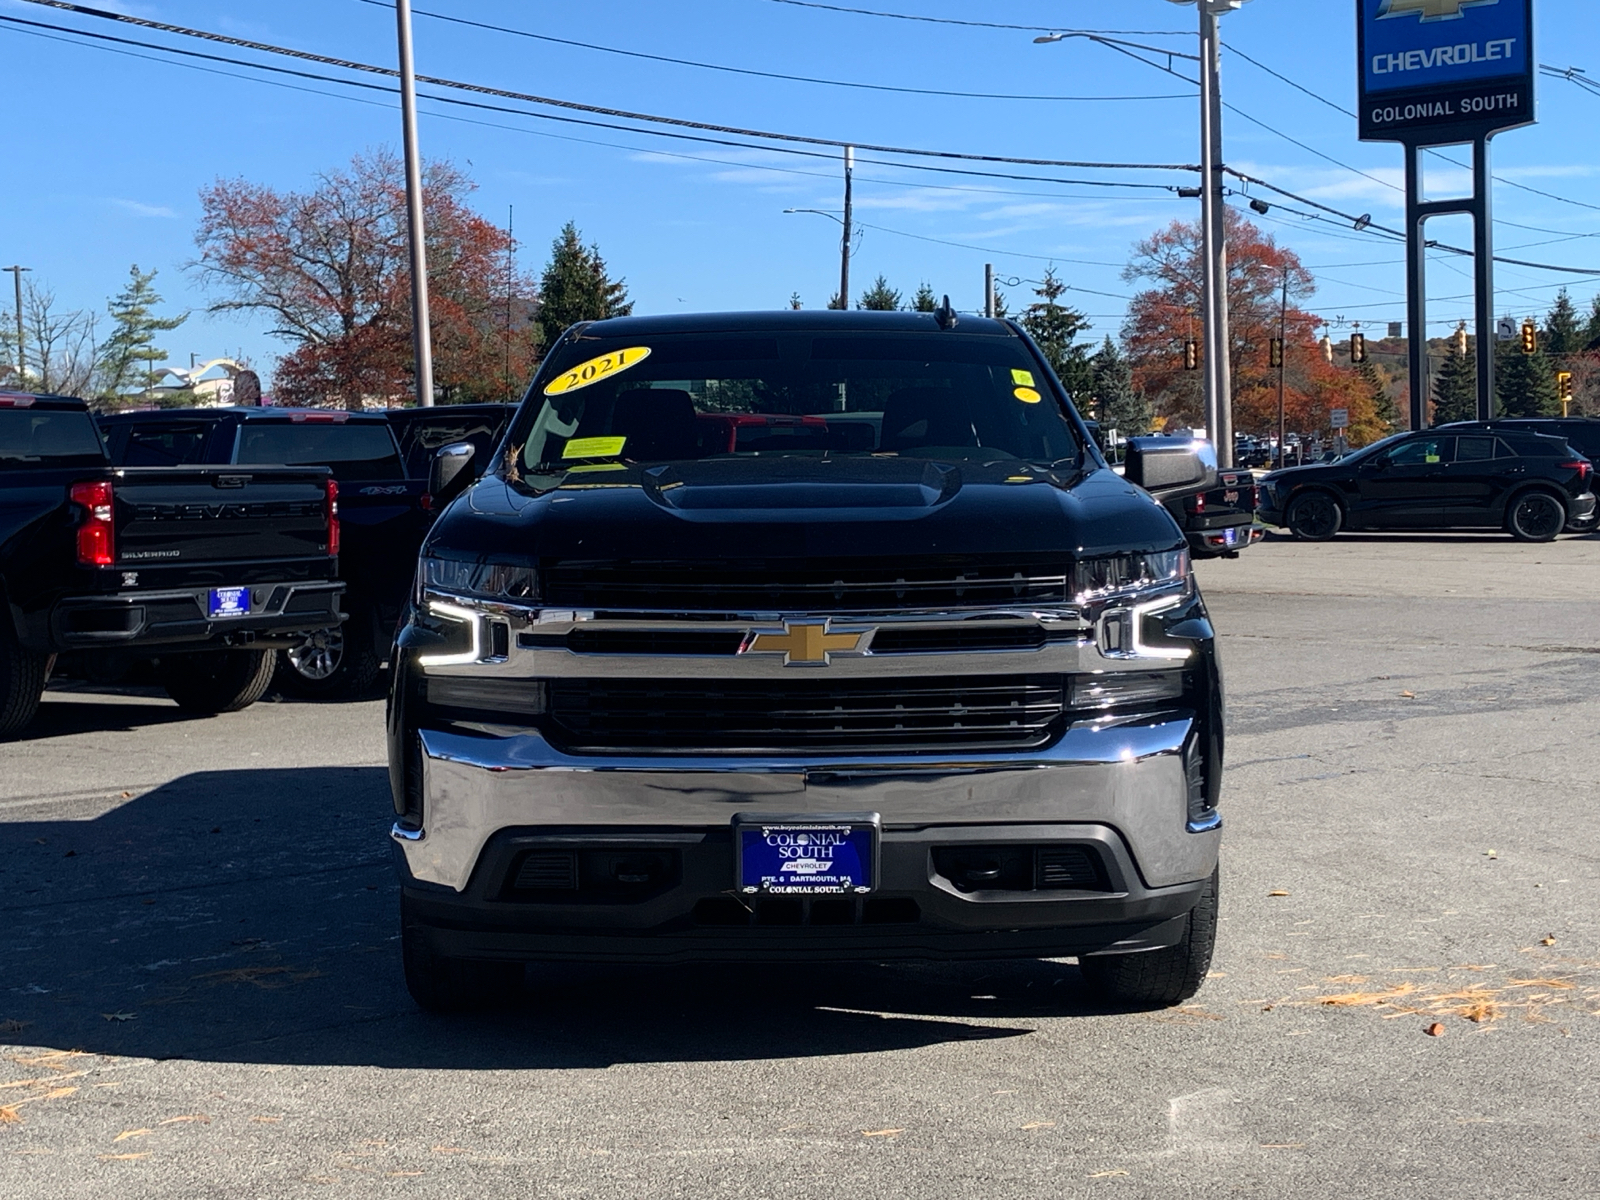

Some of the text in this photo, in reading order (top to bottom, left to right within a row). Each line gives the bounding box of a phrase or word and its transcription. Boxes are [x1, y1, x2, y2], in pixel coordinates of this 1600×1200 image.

[1373, 38, 1516, 74] CHEVROLET
[1372, 93, 1518, 123] COLONIAL SOUTH
[565, 352, 626, 388] 2021
[122, 551, 180, 559] SILVERADO
[767, 833, 846, 846] COLONIAL
[779, 846, 833, 858] SOUTH
